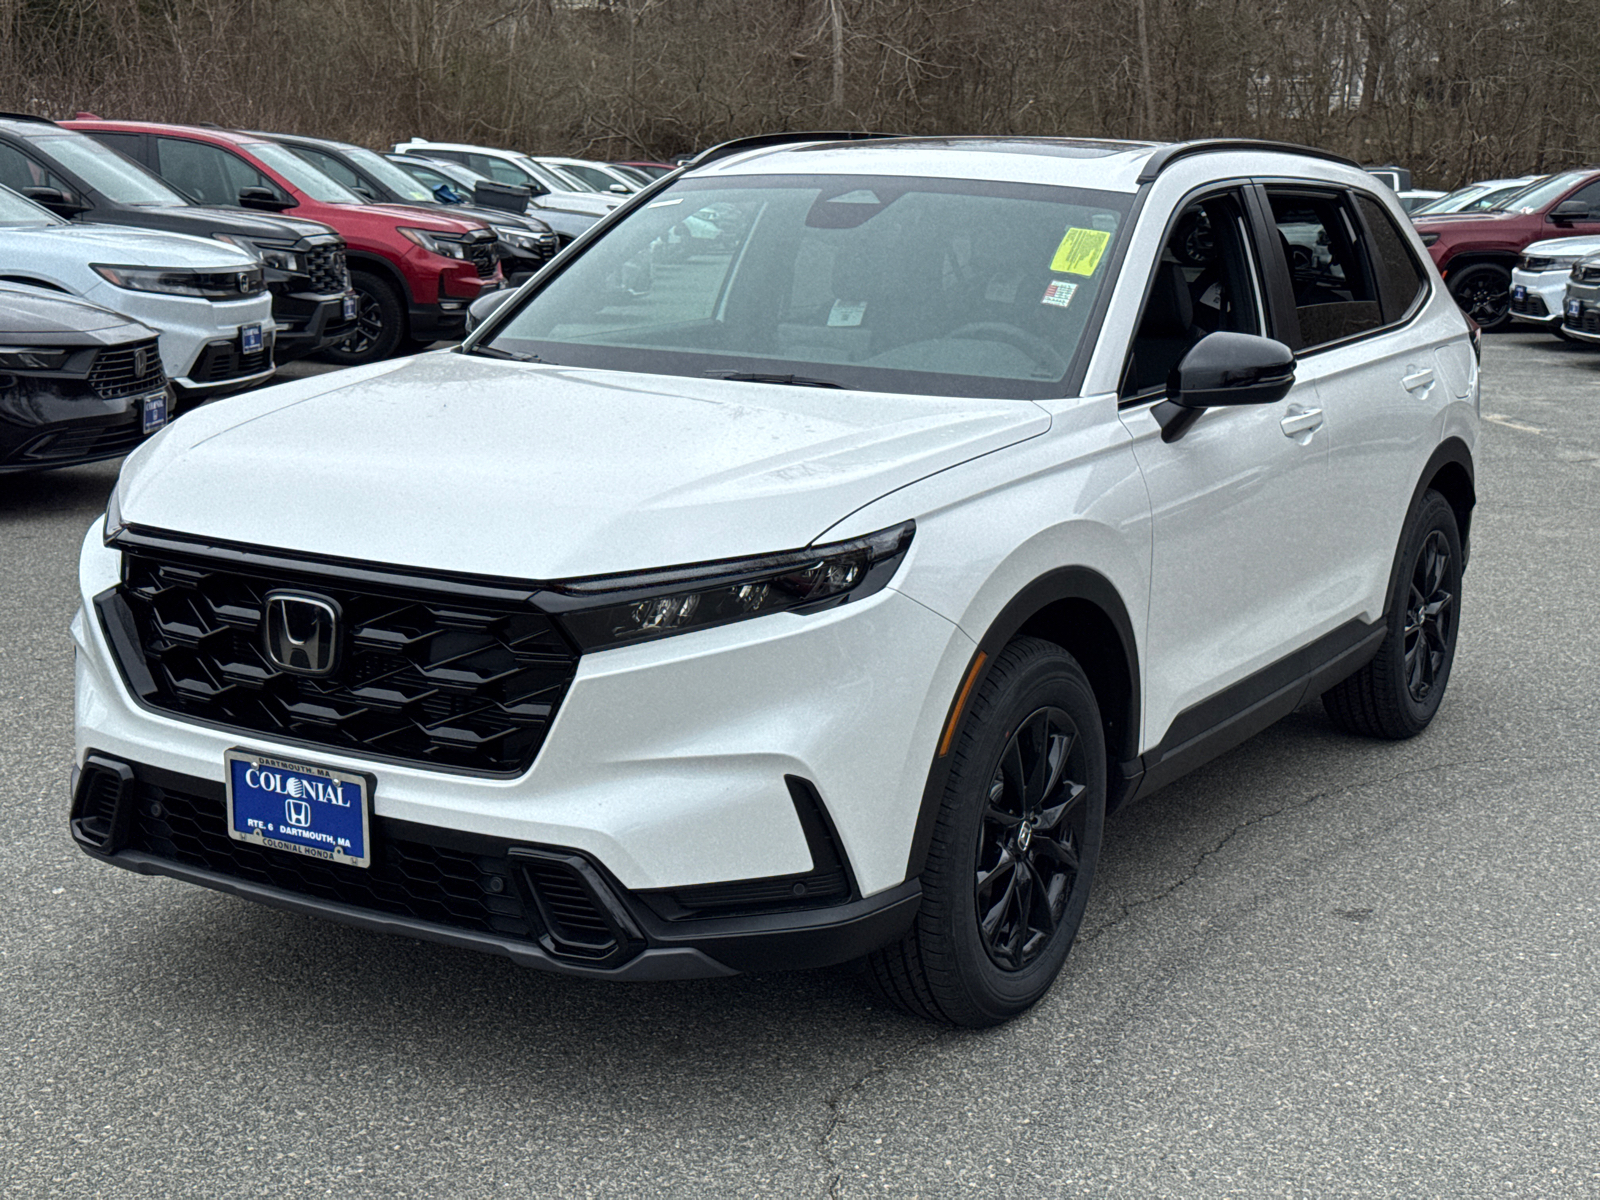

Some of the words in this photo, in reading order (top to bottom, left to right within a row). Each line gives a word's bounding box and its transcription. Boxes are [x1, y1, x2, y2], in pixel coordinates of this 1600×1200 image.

[316, 768, 331, 778] MA
[245, 768, 351, 808] COLONIAL
[247, 818, 267, 830] RTE.
[267, 822, 274, 832] 6
[279, 825, 336, 846] DARTMOUTH,
[337, 837, 352, 848] MA
[262, 837, 303, 854] COLONIAL
[304, 847, 335, 861] HONDA
